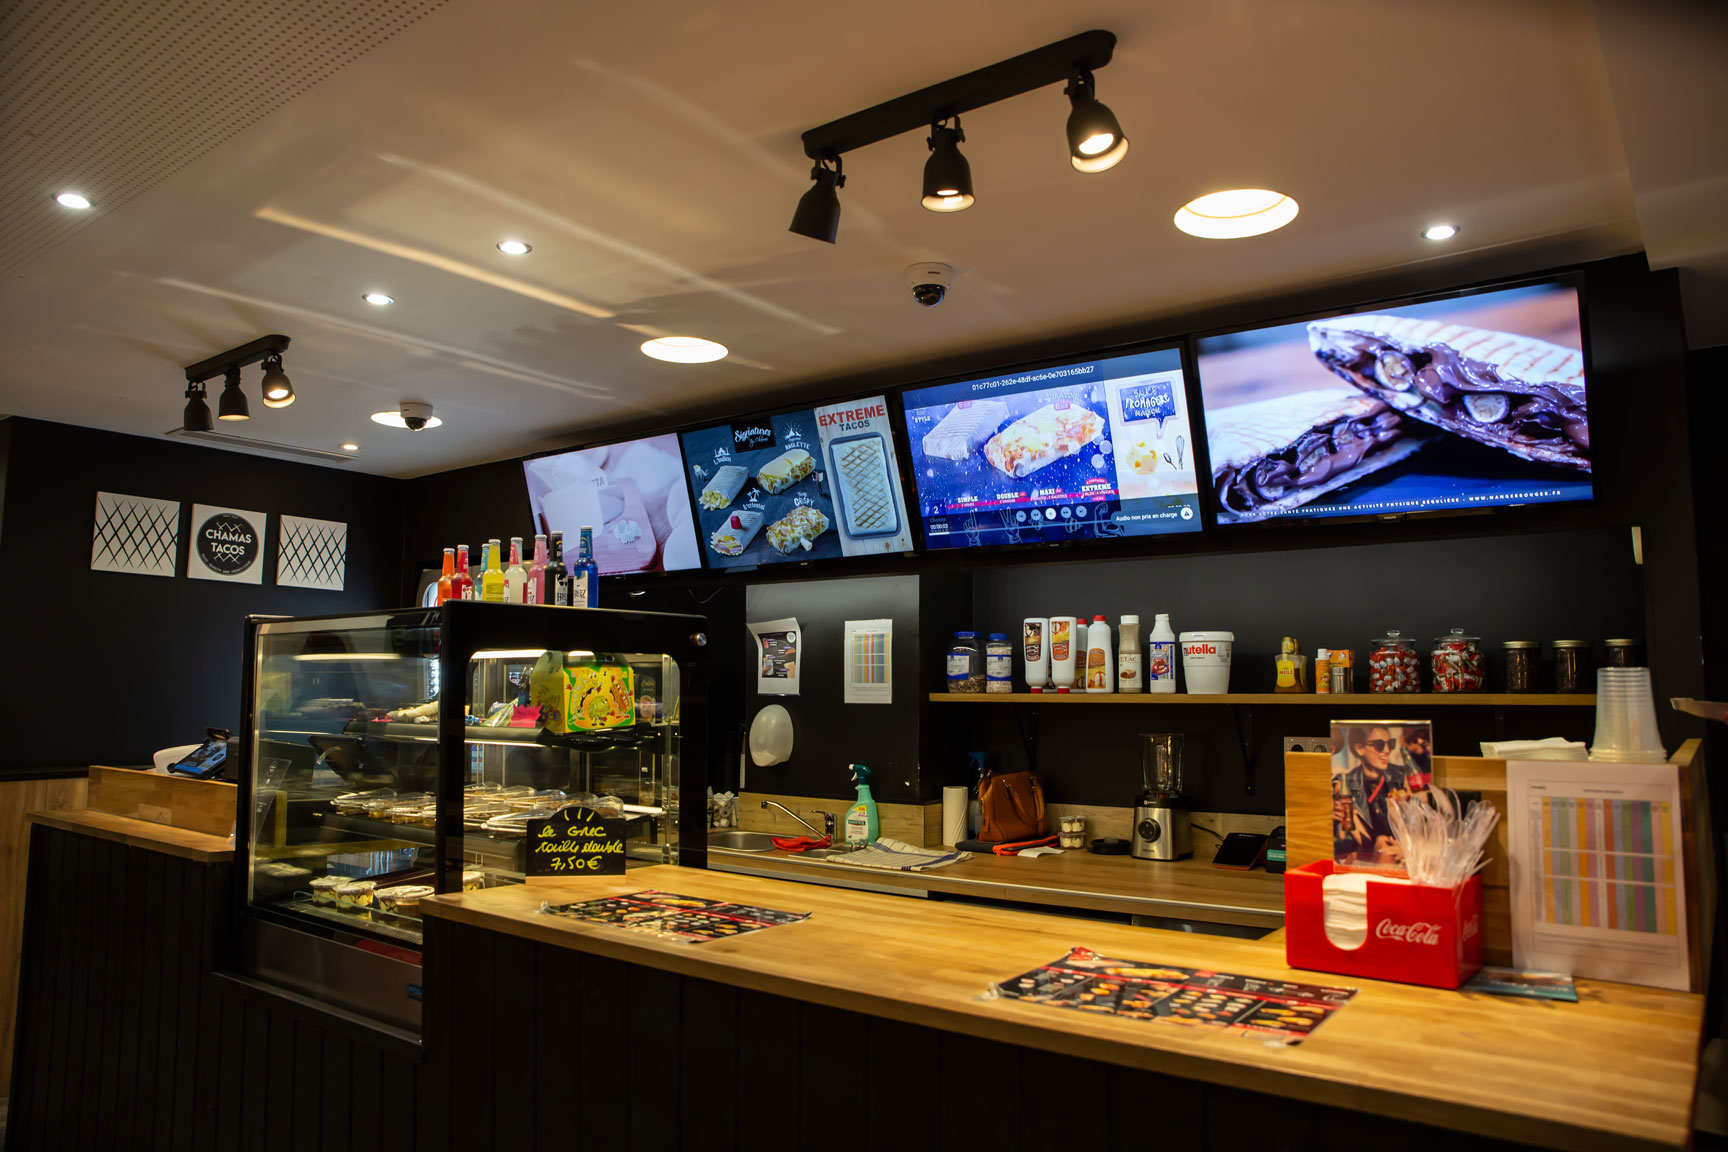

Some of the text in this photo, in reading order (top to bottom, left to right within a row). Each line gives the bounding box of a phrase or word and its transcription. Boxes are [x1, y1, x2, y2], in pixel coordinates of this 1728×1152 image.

[818, 404, 886, 427] EXTREME
[838, 420, 870, 432] TACOS
[734, 426, 772, 442] Signatures
[1082, 484, 1112, 492] EXTREME
[1468, 490, 1561, 502] WWW.MANGERBOUGER.FR
[934, 506, 939, 514] 2
[205, 529, 252, 543] CHAMAS
[211, 542, 245, 555] TACOS
[537, 825, 557, 838] le
[535, 839, 624, 854] taille double
[1376, 918, 1442, 946] Coca-Cola
